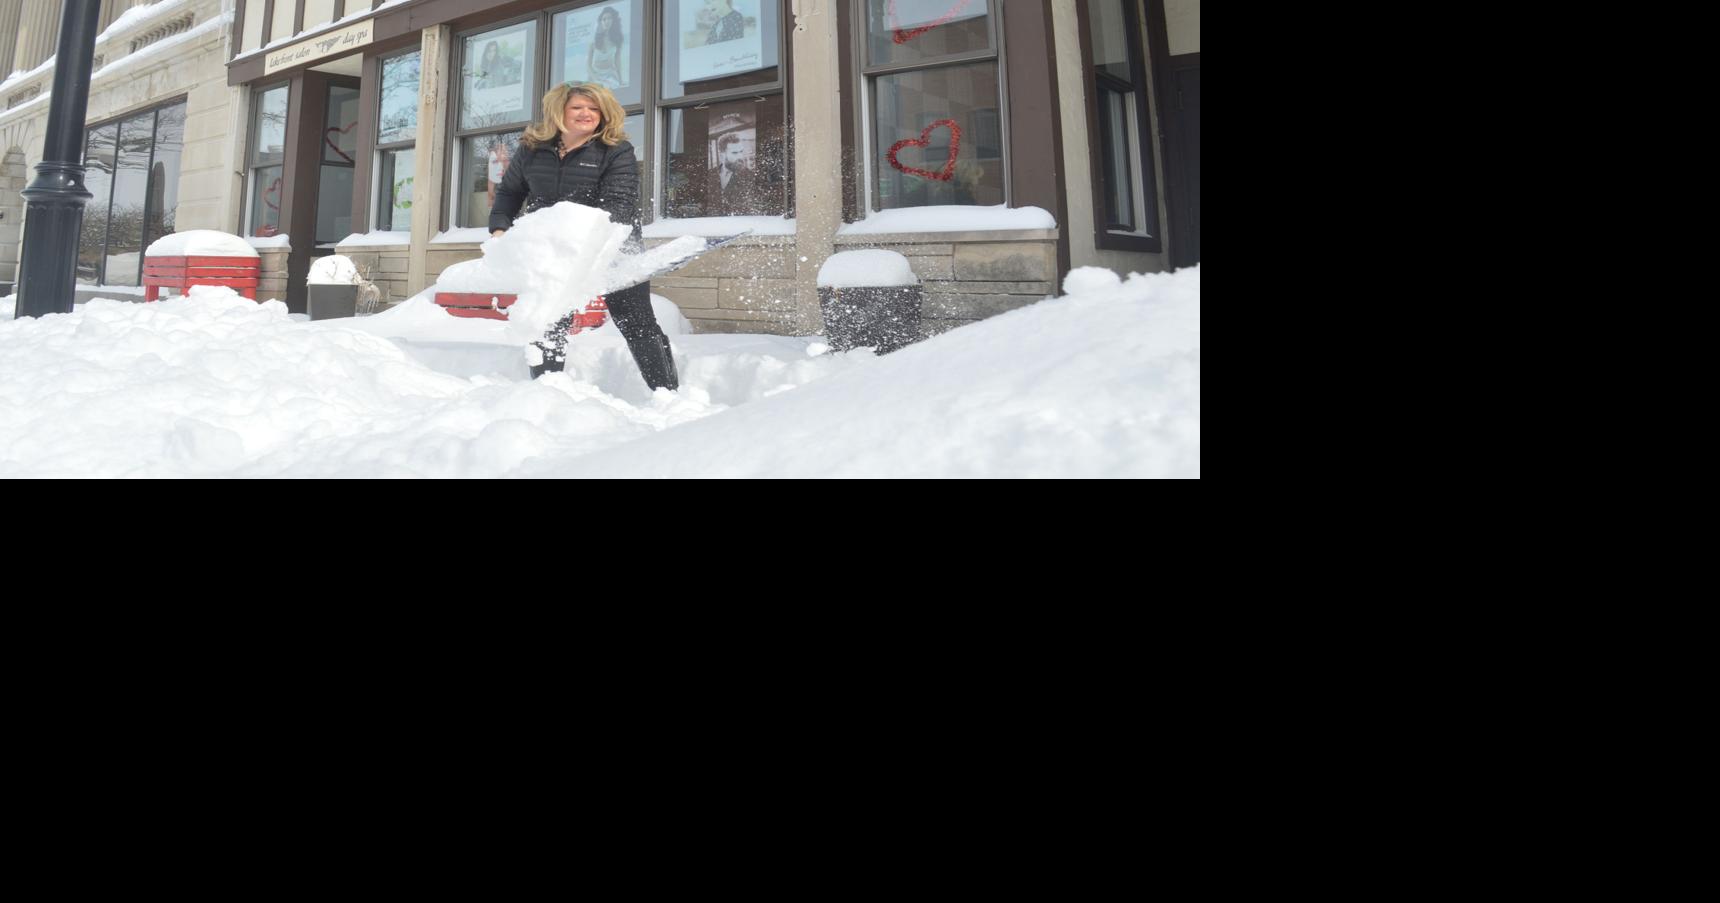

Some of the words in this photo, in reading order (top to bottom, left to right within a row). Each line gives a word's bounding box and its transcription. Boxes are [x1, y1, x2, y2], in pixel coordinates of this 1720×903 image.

[295, 47, 310, 59] salon
[342, 31, 355, 46] day
[356, 28, 368, 44] spa
